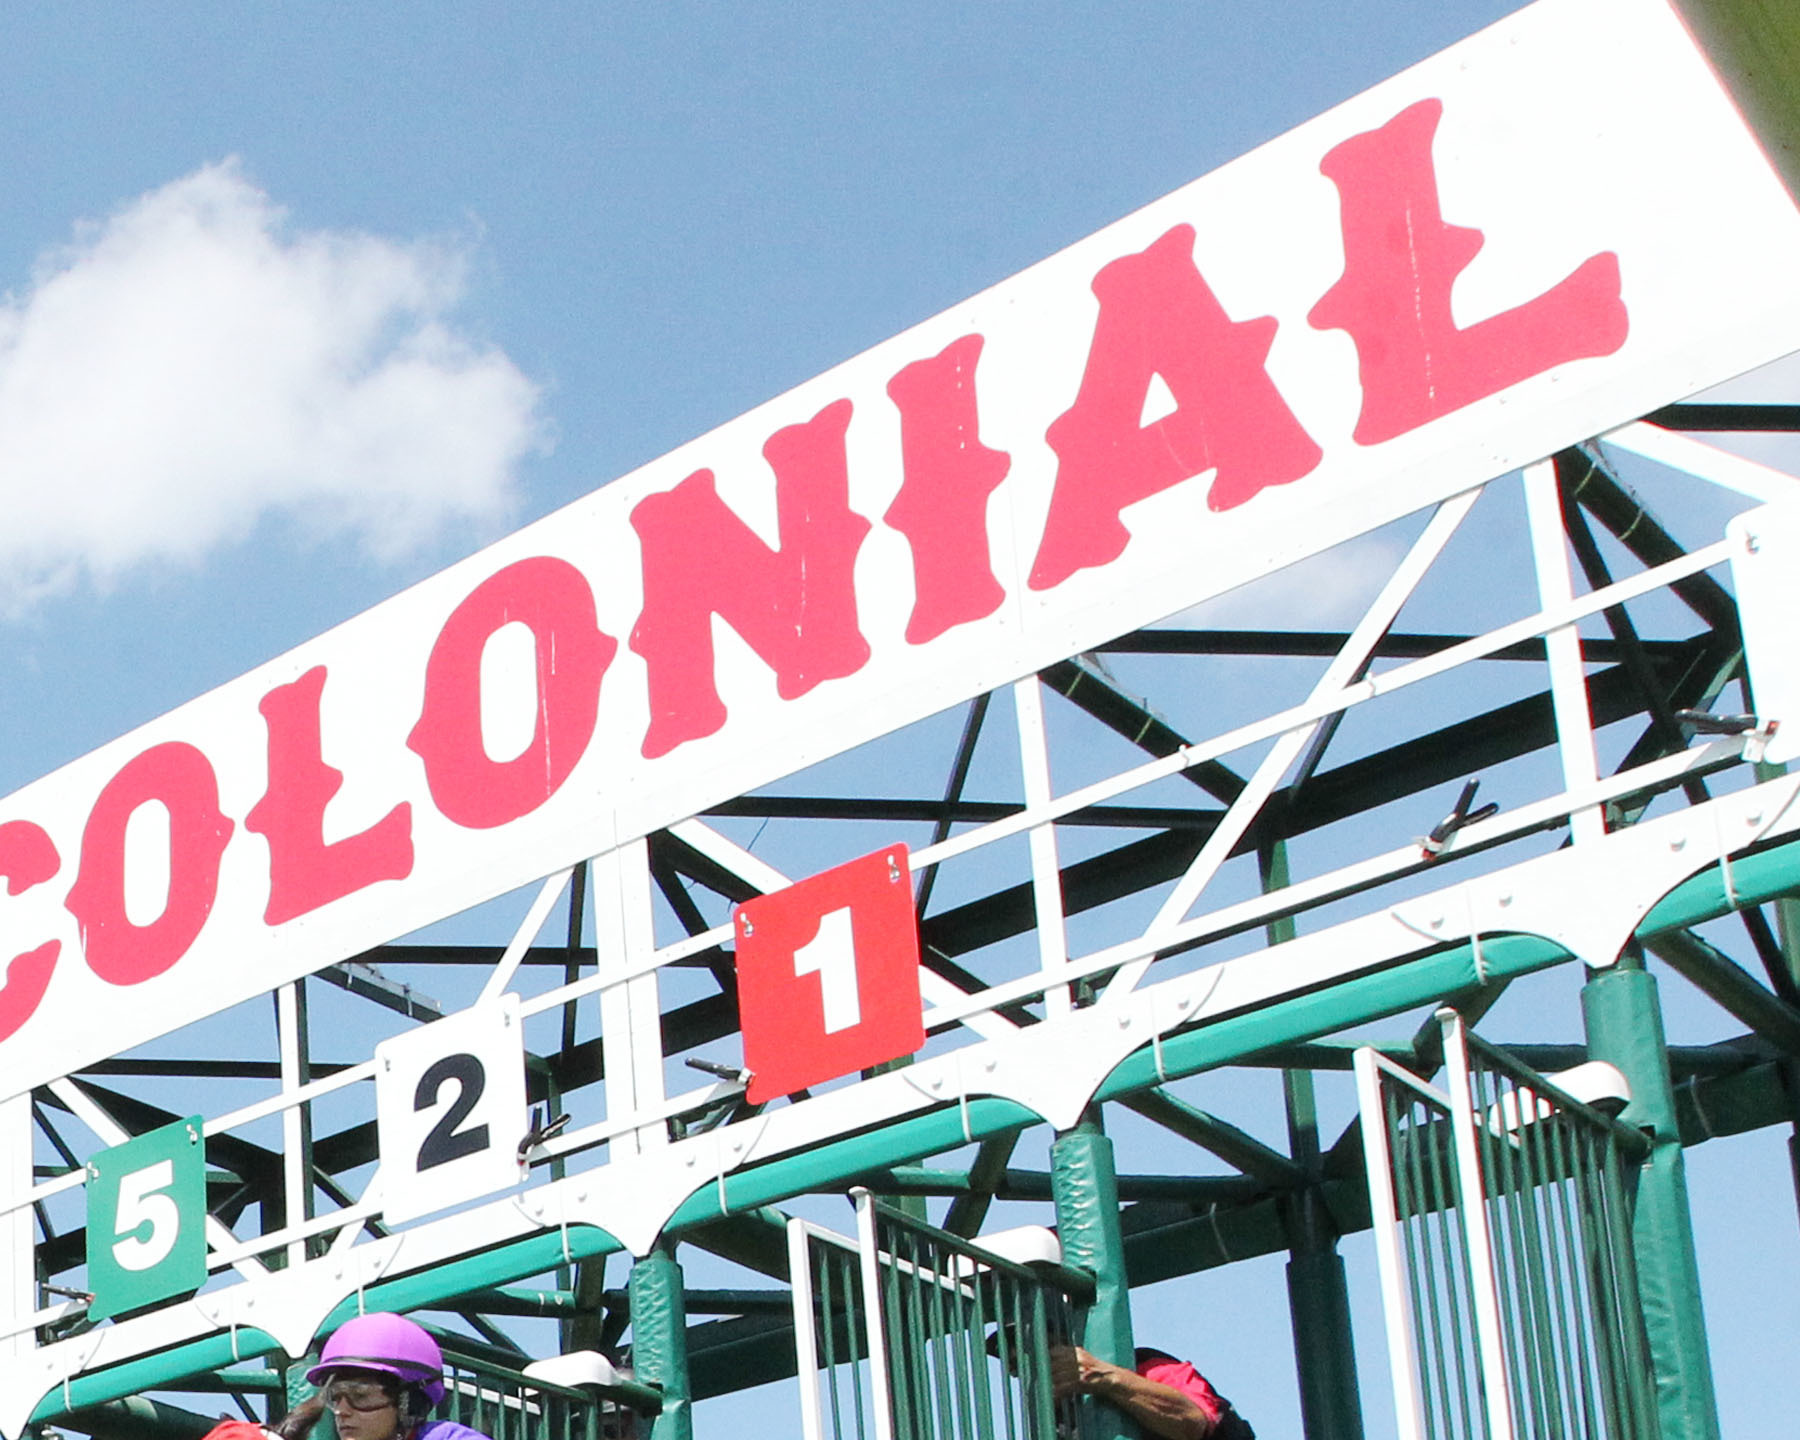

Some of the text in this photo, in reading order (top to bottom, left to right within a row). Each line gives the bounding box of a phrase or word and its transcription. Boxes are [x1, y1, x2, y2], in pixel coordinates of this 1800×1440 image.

[793, 905, 861, 1035] 1
[413, 1053, 490, 1173] 2
[111, 1158, 180, 1273] 5
